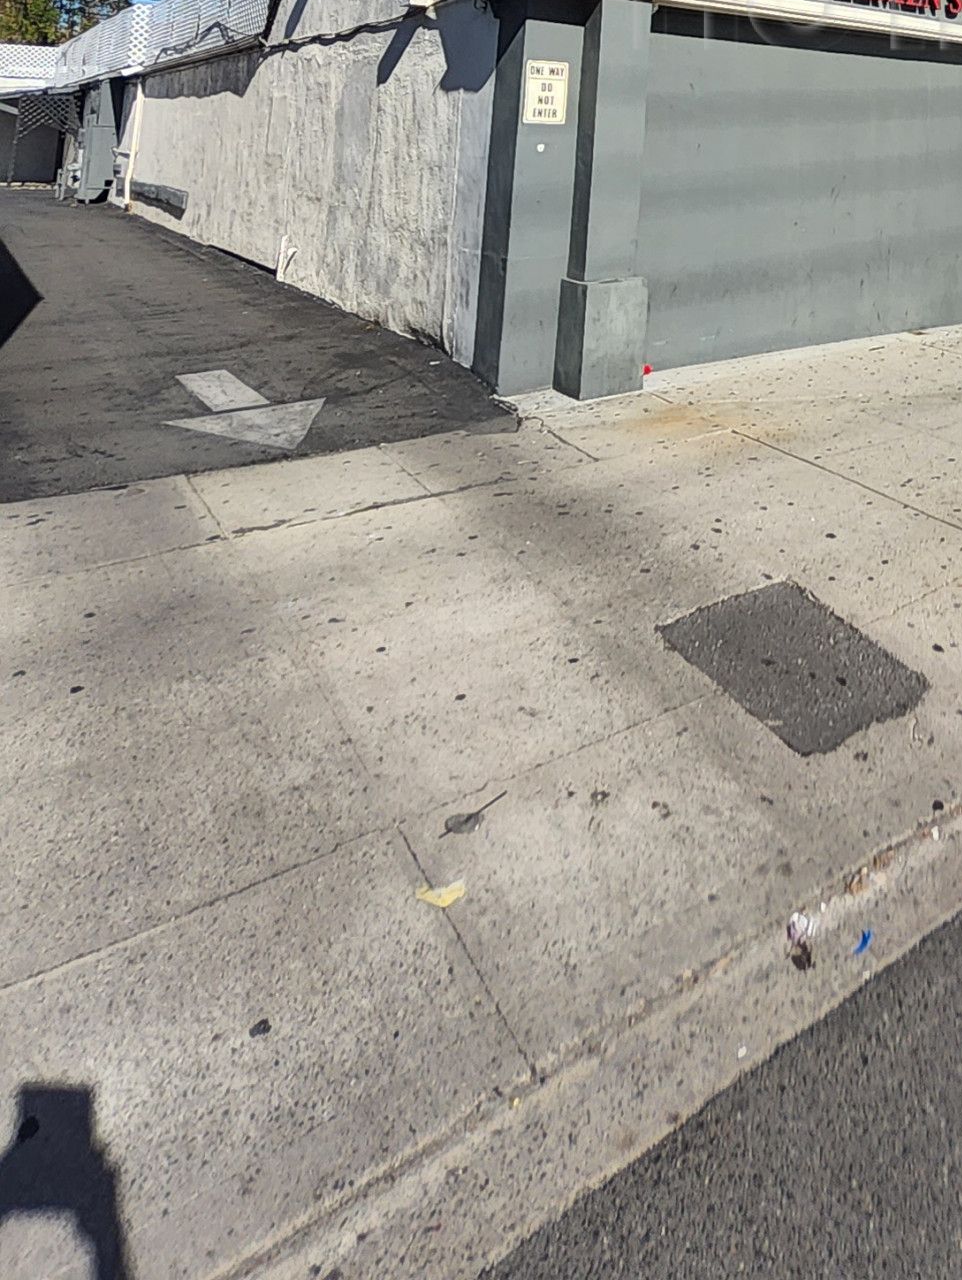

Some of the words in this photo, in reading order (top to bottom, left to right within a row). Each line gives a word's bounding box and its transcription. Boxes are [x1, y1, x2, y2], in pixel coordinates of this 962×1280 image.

[530, 65, 544, 76] ONE
[549, 66, 565, 77] WAY
[541, 82, 553, 92] DO
[537, 96, 555, 106] NOT
[532, 107, 558, 118] ENTER
